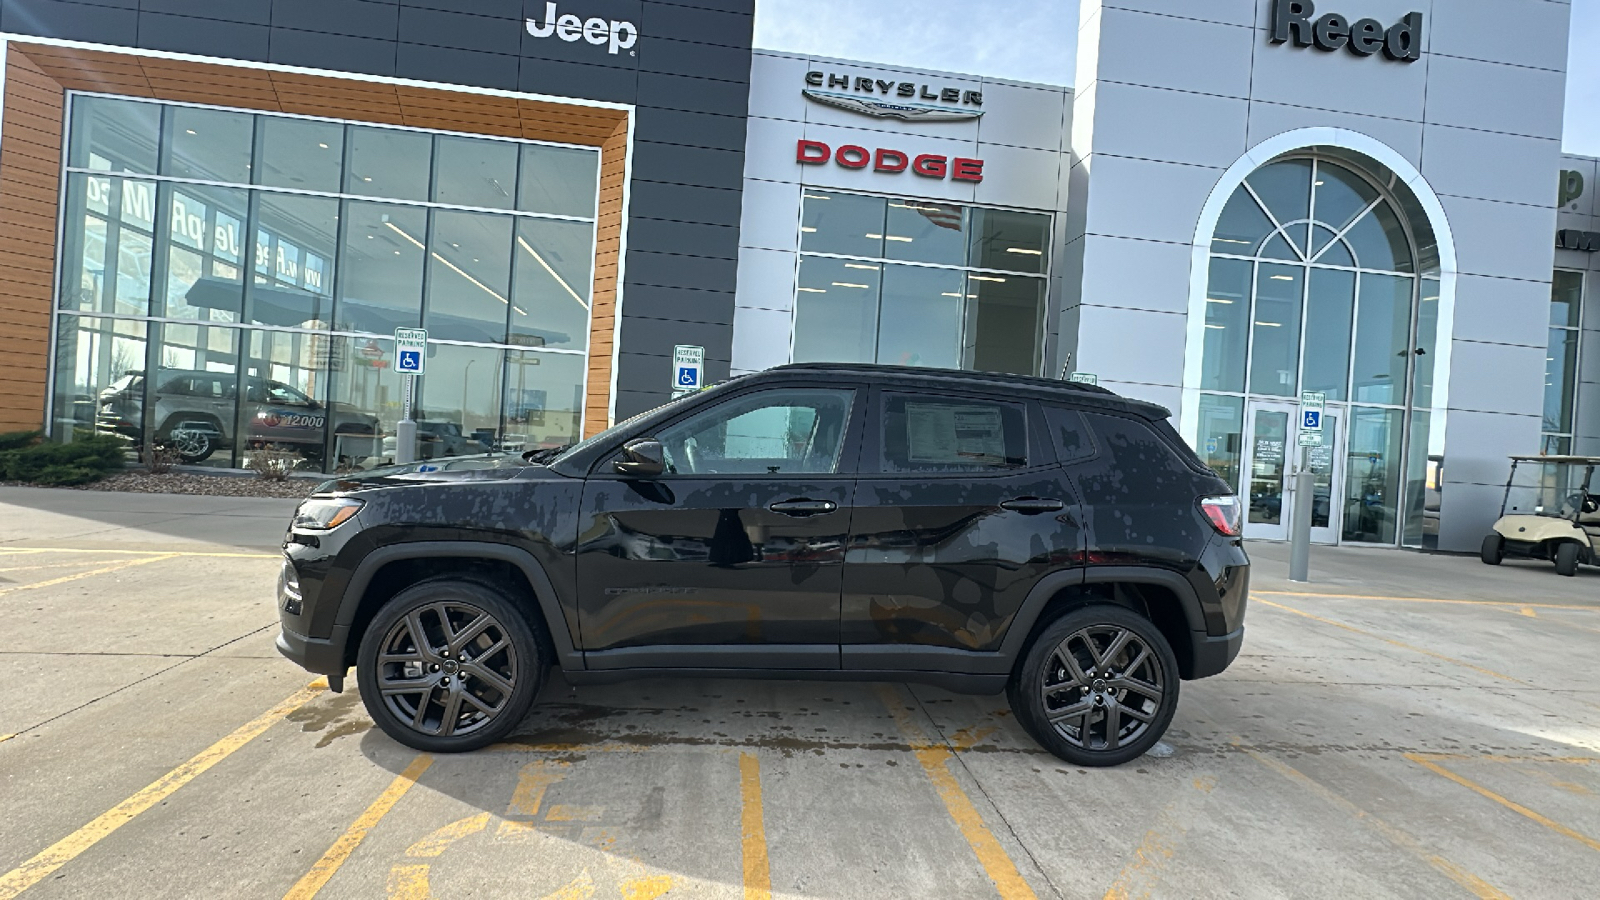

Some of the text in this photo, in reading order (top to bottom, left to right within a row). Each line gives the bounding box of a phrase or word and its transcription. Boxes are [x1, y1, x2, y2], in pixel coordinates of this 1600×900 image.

[525, 1, 638, 55] Jeep
[1270, 0, 1423, 62] Reed
[805, 71, 984, 105] CHRYSLER
[796, 139, 984, 183] DODGE
[398, 332, 424, 340] RESERVED
[398, 339, 424, 347] PARKING
